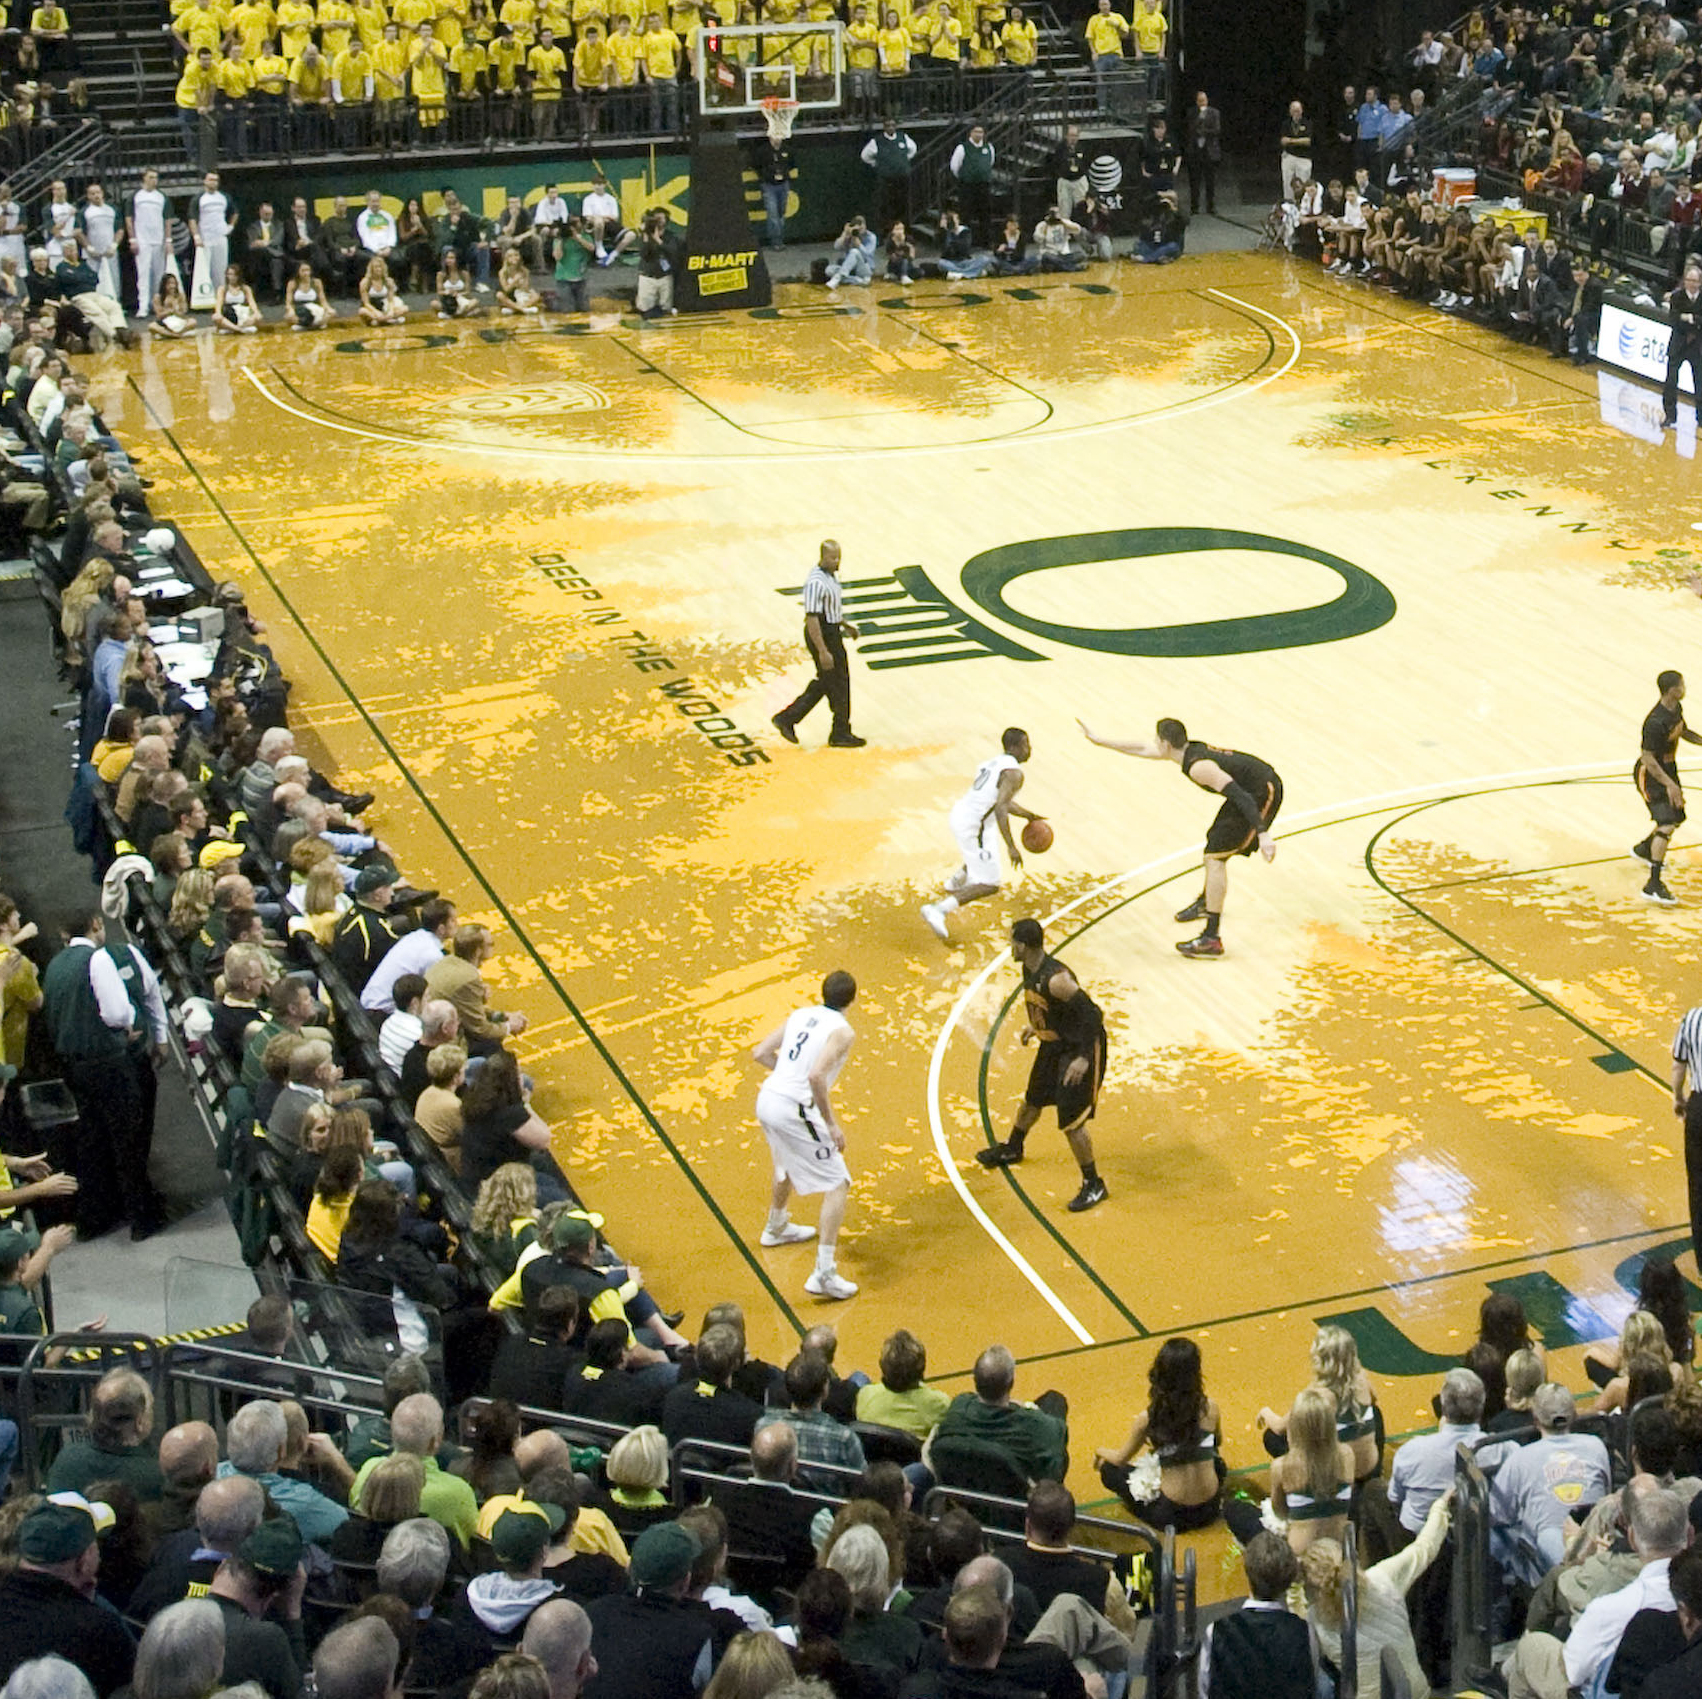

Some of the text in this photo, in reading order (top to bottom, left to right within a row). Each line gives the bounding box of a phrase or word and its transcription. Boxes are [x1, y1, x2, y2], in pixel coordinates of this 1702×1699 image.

[1640, 334, 1669, 365] at&
[530, 552, 772, 767] DEEP IN THE WOODS
[788, 1031, 810, 1062] 3
